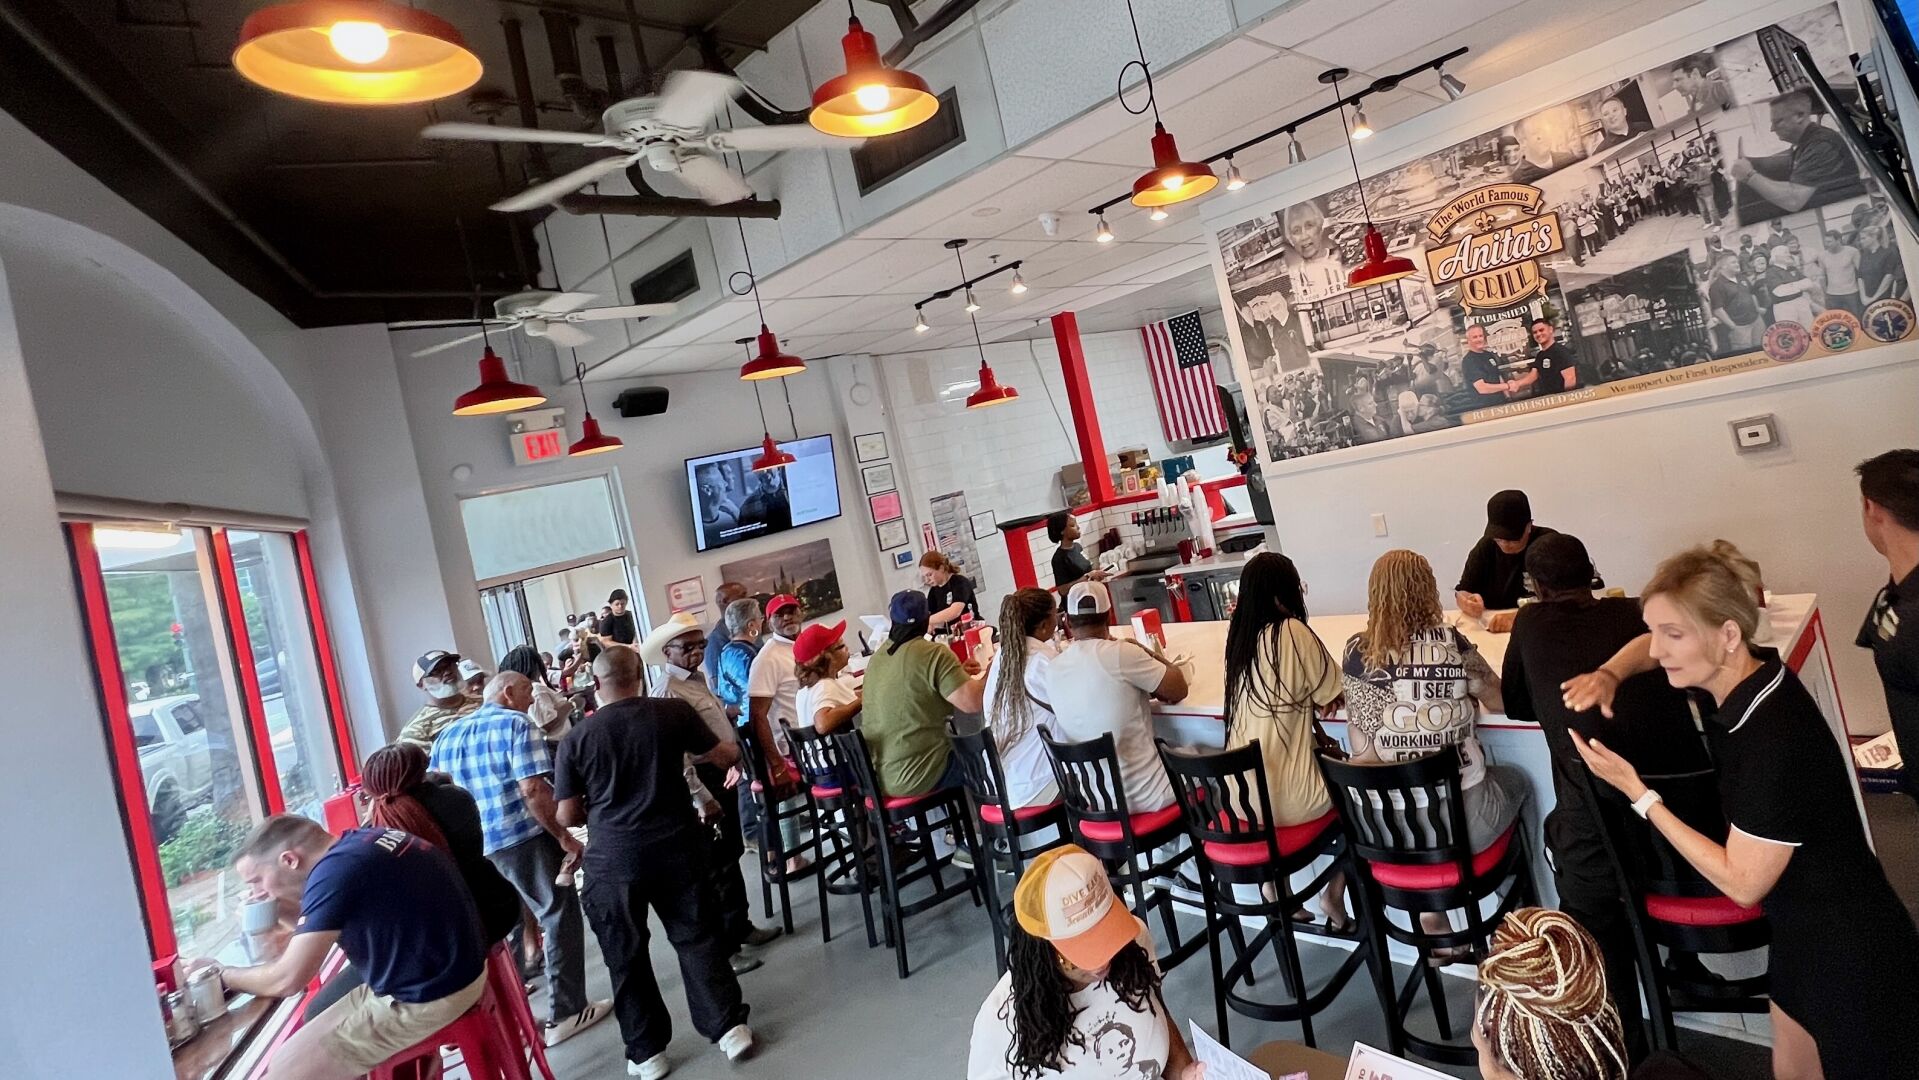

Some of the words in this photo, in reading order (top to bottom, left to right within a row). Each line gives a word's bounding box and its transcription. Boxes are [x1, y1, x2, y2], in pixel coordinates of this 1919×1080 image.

[1435, 212, 1453, 229] The
[1452, 192, 1485, 212] World
[1488, 189, 1529, 202] Famous
[1437, 220, 1552, 280] Anita's
[1469, 265, 1532, 300] GRILL
[1610, 384, 1625, 394] We
[1628, 377, 1663, 391] support
[1665, 373, 1683, 384] Our
[1685, 368, 1707, 379] First
[1710, 356, 1769, 375] Responders
[1568, 388, 1596, 402] 2025
[523, 431, 561, 461] EXIT
[1395, 667, 1409, 677] OF
[1413, 667, 1430, 677] MY
[1413, 681, 1419, 699] I
[1425, 682, 1453, 699] SEE
[1382, 700, 1473, 733] GOD
[1380, 733, 1440, 747] WORKING
[1446, 731, 1456, 744] IT
[1062, 889, 1088, 906] DIVE
